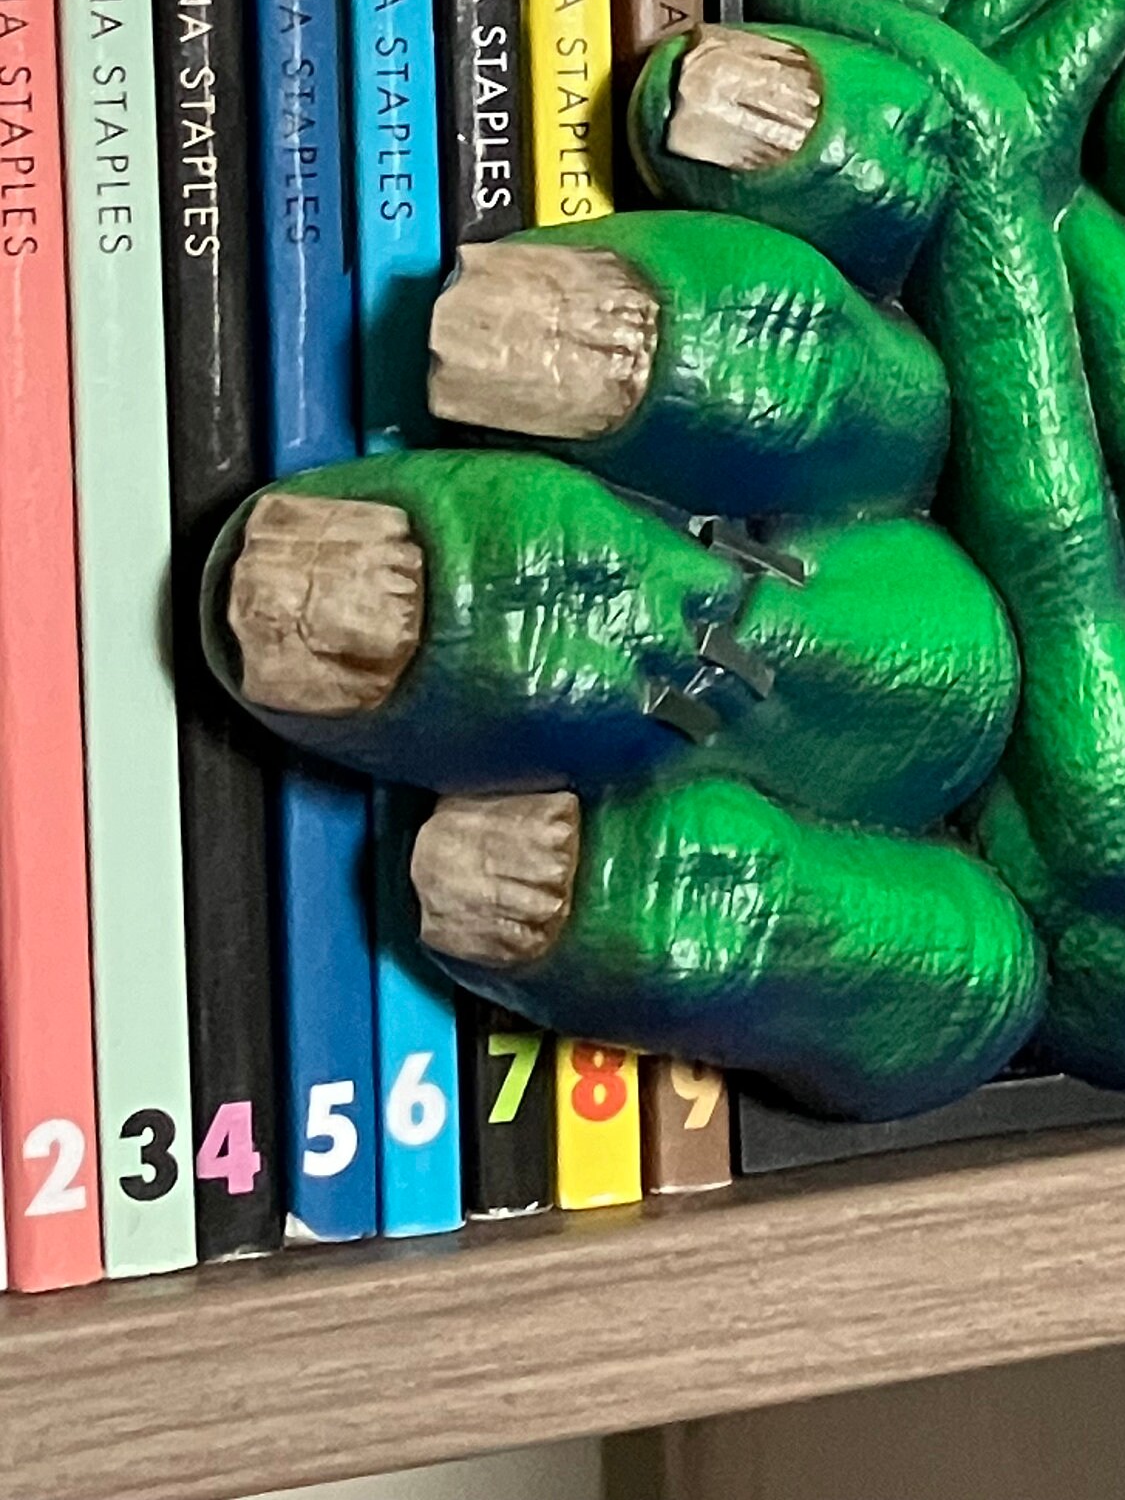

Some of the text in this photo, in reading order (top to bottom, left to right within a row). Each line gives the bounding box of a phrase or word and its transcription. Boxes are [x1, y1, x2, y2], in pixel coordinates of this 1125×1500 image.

[0, 64, 39, 257] STAPLES
[92, 64, 134, 254] STAPLES
[179, 66, 221, 259] STAPLES
[281, 56, 322, 246] STAPLES
[375, 36, 413, 223] STAPLES
[471, 24, 512, 211] STAPLES
[555, 36, 593, 218] STAPLES
[385, 1051, 447, 1146] 6
[487, 1032, 545, 1124] 7
[570, 1043, 628, 1122] 8
[670, 1062, 724, 1130] 9
[23, 1118, 88, 1217] 2
[118, 1108, 180, 1202] 3
[196, 1100, 262, 1195] 4
[302, 1081, 359, 1178] 5
